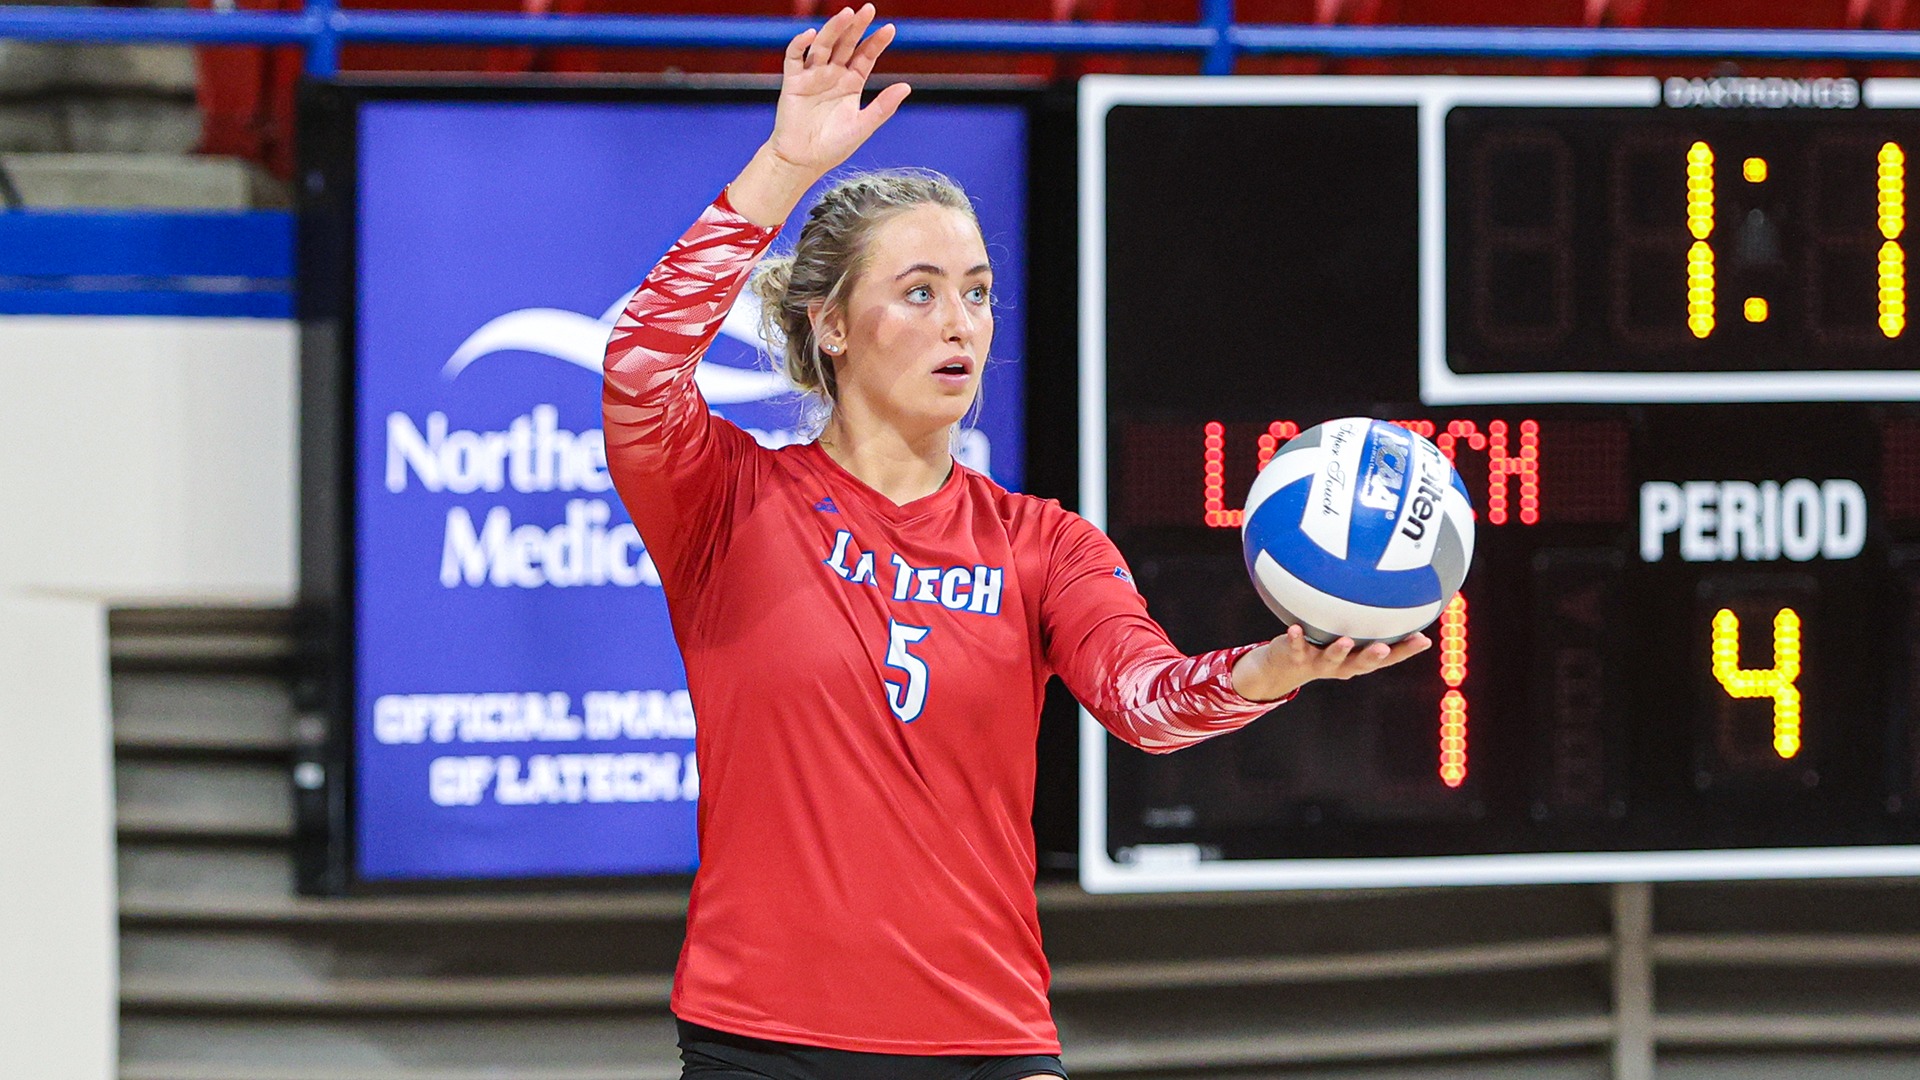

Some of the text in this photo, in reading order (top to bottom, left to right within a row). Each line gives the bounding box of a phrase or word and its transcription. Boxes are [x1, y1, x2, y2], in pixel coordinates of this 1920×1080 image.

[1323, 461, 1346, 516] Touch
[1360, 425, 1410, 511] NCAA
[1640, 478, 1867, 563] PERIOD
[822, 529, 1004, 616] LA TECH
[884, 616, 932, 724] 5
[1440, 591, 1467, 788] 1
[1711, 607, 1801, 759] 4
[373, 692, 585, 745] OFFICIAL
